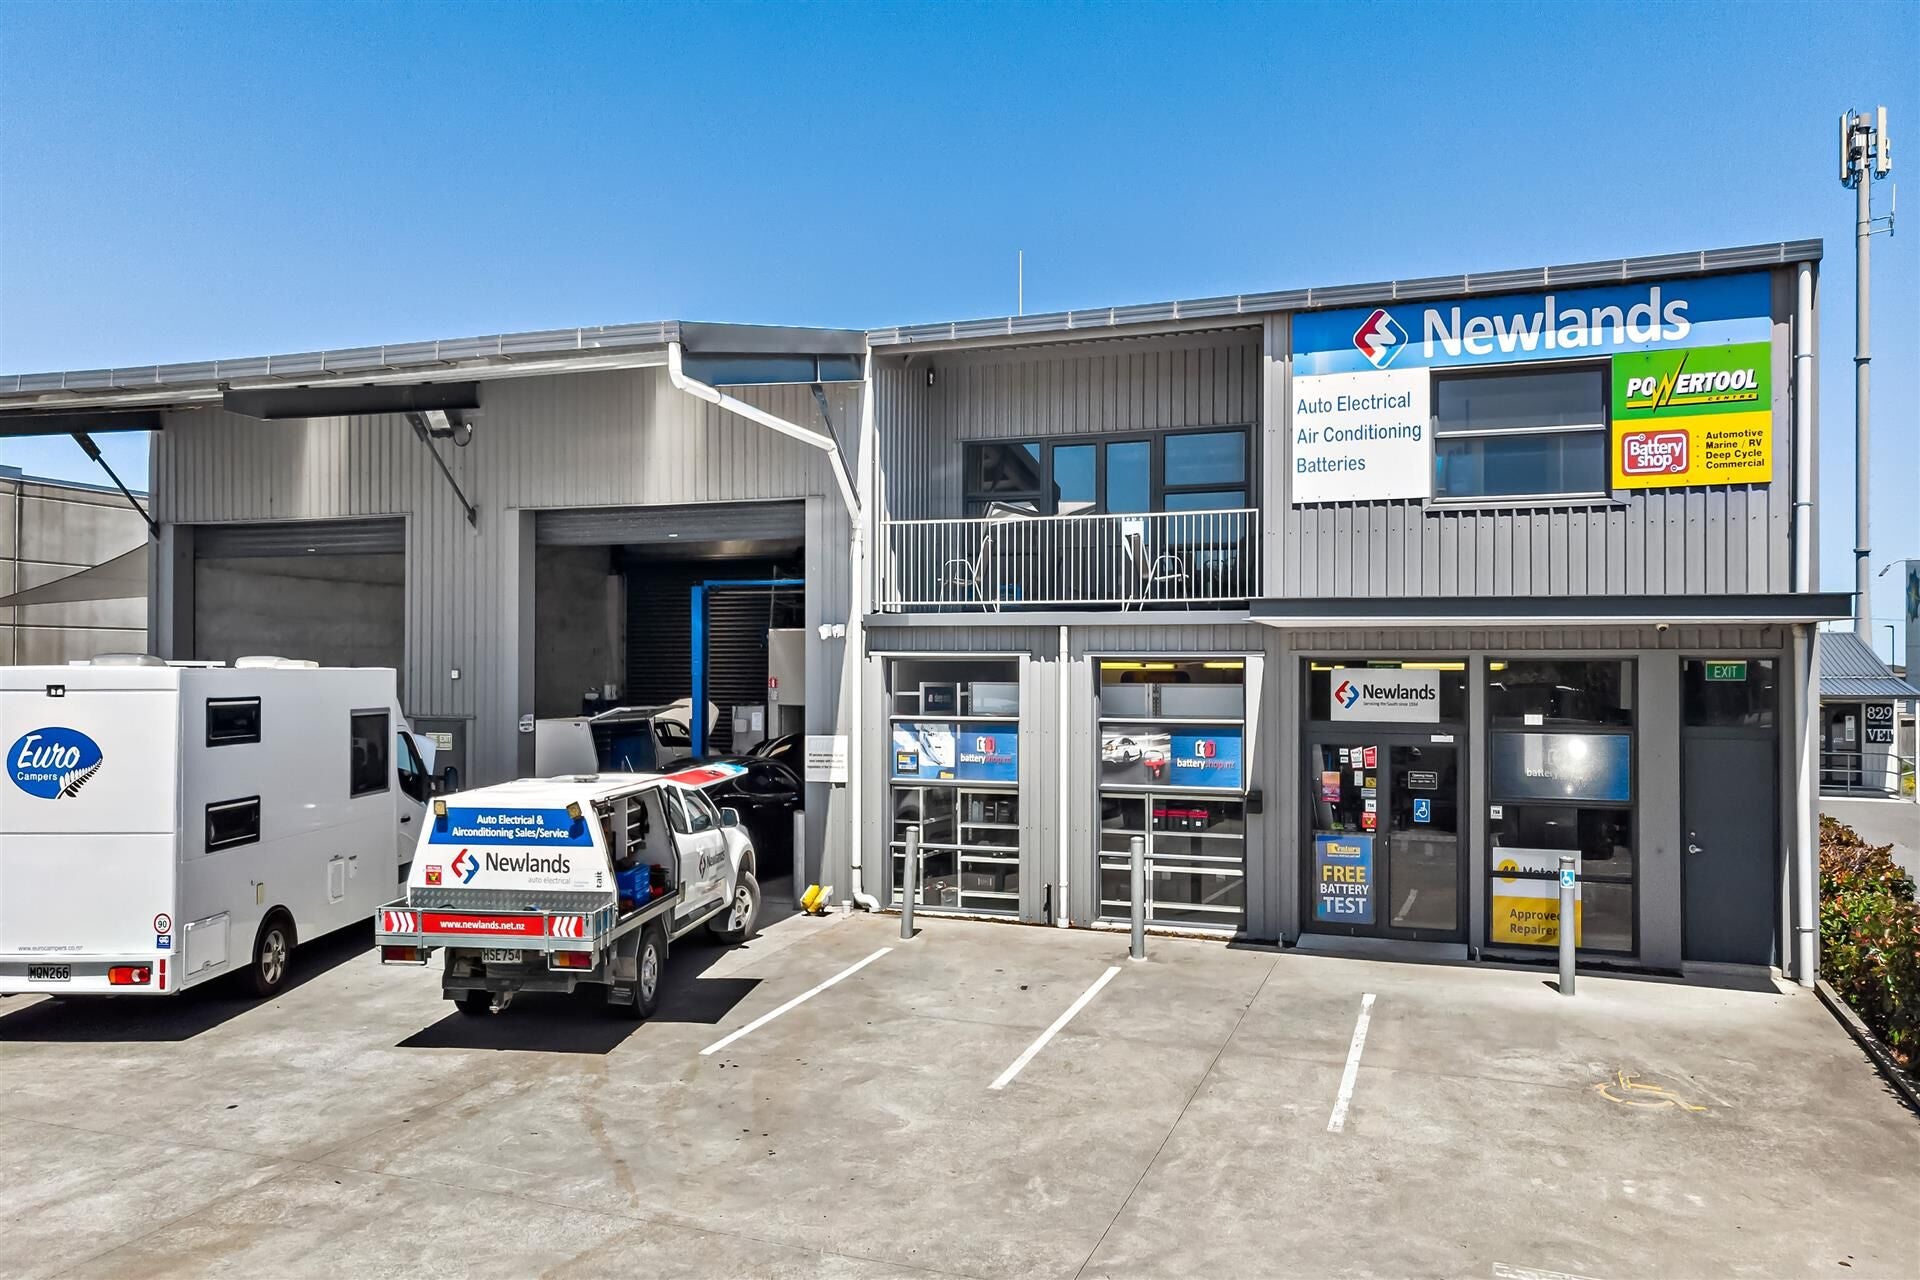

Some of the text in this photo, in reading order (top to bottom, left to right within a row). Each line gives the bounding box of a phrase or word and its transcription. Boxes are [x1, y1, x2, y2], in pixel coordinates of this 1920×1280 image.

[1423, 287, 1691, 359] Newlands
[1626, 351, 1759, 412] POWERTOOL
[1297, 391, 1411, 414] Auto Electrical
[1707, 393, 1754, 402] CENTRE
[1297, 422, 1422, 444] Air Conditioning
[1705, 429, 1764, 440] Automotive
[1630, 438, 1682, 457] Battery
[1705, 440, 1738, 449] Marine
[1748, 438, 1762, 447] RV
[1637, 451, 1673, 467] shop
[1705, 449, 1762, 461] Deep Cycle
[1296, 455, 1367, 474] Batteries
[1705, 458, 1765, 469] Commercial
[1714, 665, 1737, 678] EXIT
[1363, 683, 1436, 700] Newlands
[1867, 706, 1893, 720] 829
[17, 734, 80, 769] Euro
[17, 771, 58, 782] Campers
[476, 814, 544, 825] Auto Electrical &
[452, 826, 569, 839] Airconditioning Sales/Service
[485, 852, 571, 874] Newlands
[1322, 865, 1366, 883] FREE
[1320, 883, 1369, 895] BATTERY
[1323, 896, 1367, 914] TEST
[157, 920, 167, 929] 90
[440, 920, 526, 931] www.newlands.net.nz
[1510, 923, 1558, 936] Repairer
[483, 949, 521, 961] HSE754
[29, 966, 69, 979] MQN266
